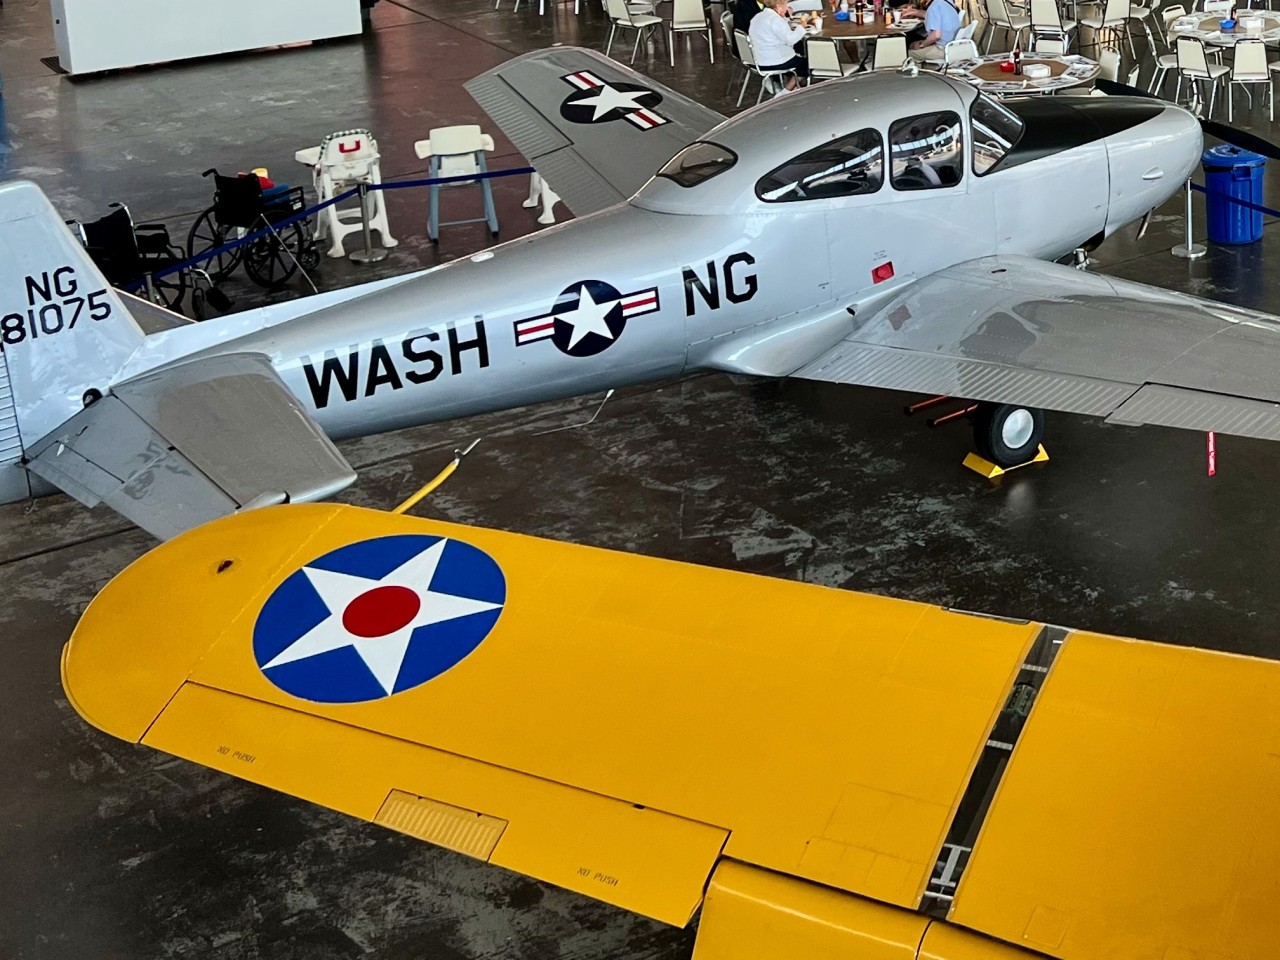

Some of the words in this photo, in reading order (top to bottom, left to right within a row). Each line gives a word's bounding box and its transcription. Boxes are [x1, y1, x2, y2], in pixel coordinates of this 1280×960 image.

[25, 266, 78, 306] NG
[680, 251, 759, 317] NG
[0, 289, 112, 352] 81075
[299, 314, 490, 410] WASH
[216, 745, 231, 756] NO
[232, 750, 256, 764] PUSH
[577, 867, 590, 878] NO
[593, 872, 620, 887] PUSH
